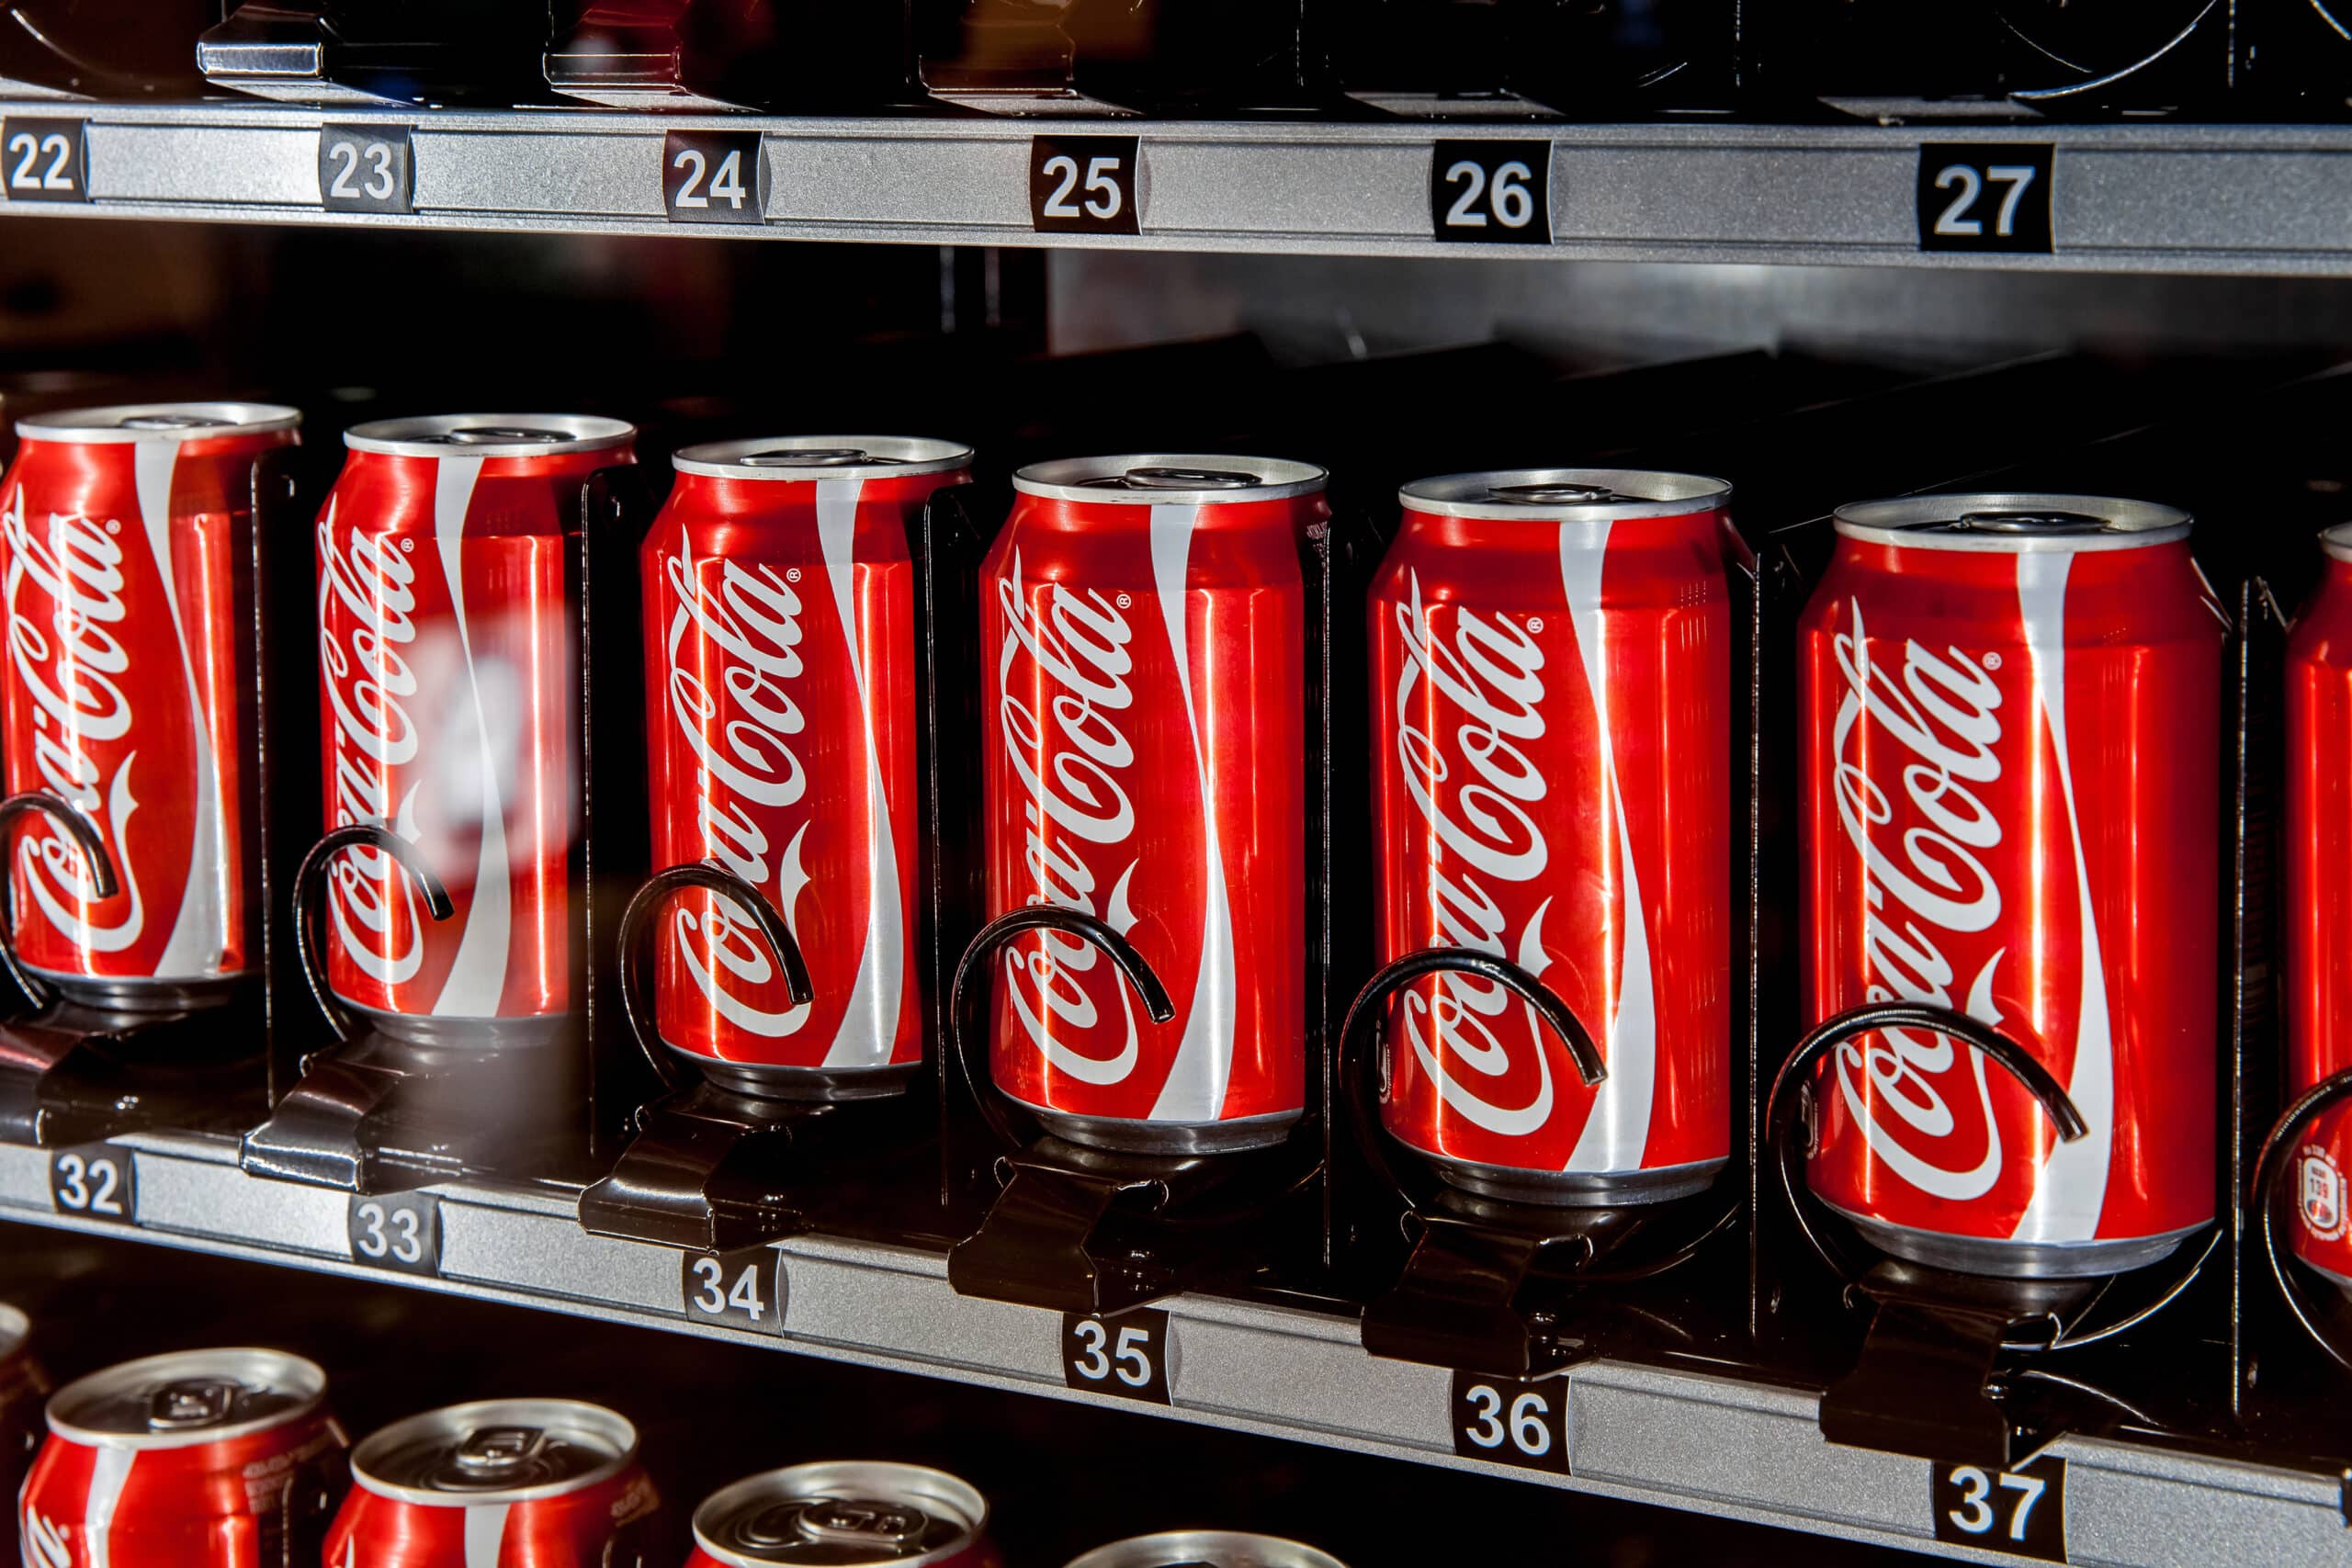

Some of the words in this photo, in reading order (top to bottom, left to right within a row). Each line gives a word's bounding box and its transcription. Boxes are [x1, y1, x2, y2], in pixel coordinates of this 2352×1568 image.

[10, 134, 74, 189] 22
[329, 142, 394, 199] 23
[673, 150, 747, 209] 24
[1042, 156, 1122, 220] 25
[1445, 162, 1532, 227] 26
[1934, 166, 2035, 236] 27
[1395, 566, 1554, 1135] Coca-Cola
[1833, 595, 2005, 1201] Coca-Cola
[58, 1153, 121, 1214] 32
[357, 1203, 422, 1262] 33
[693, 1258, 764, 1321] 34
[1074, 1320, 1151, 1387] 35
[1465, 1385, 1551, 1456] 36
[1949, 1466, 2046, 1540] 37
